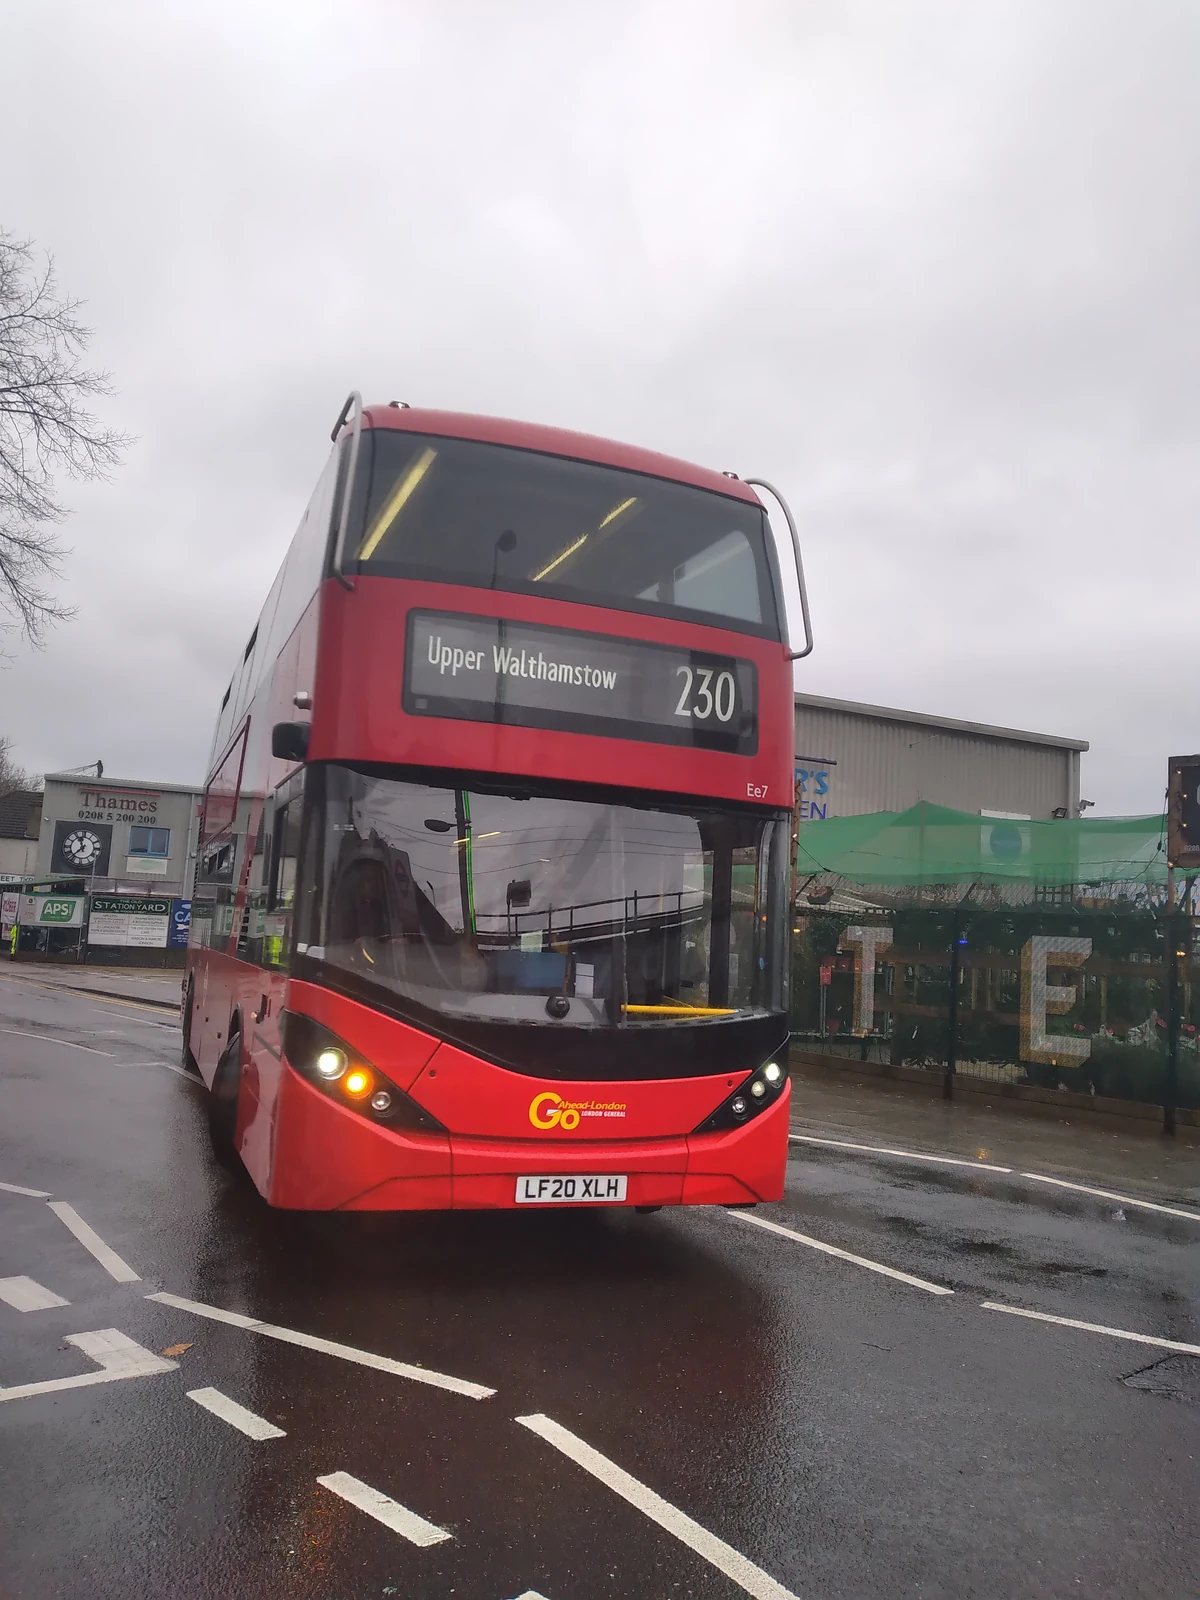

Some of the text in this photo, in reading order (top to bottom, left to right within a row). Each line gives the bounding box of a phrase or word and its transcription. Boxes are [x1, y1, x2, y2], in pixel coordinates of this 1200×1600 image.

[427, 635, 617, 690] Upper Walthamstow
[674, 665, 736, 723] 230
[746, 782, 769, 799] Ee7
[81, 791, 158, 813] Thames
[78, 810, 157, 825] 0208 5 200 200
[43, 902, 69, 916] APS
[94, 901, 166, 912] STATION YARD
[528, 1091, 581, 1131] Go
[557, 1100, 627, 1111] Ahead-London
[525, 1179, 619, 1199] LF20 XLH
